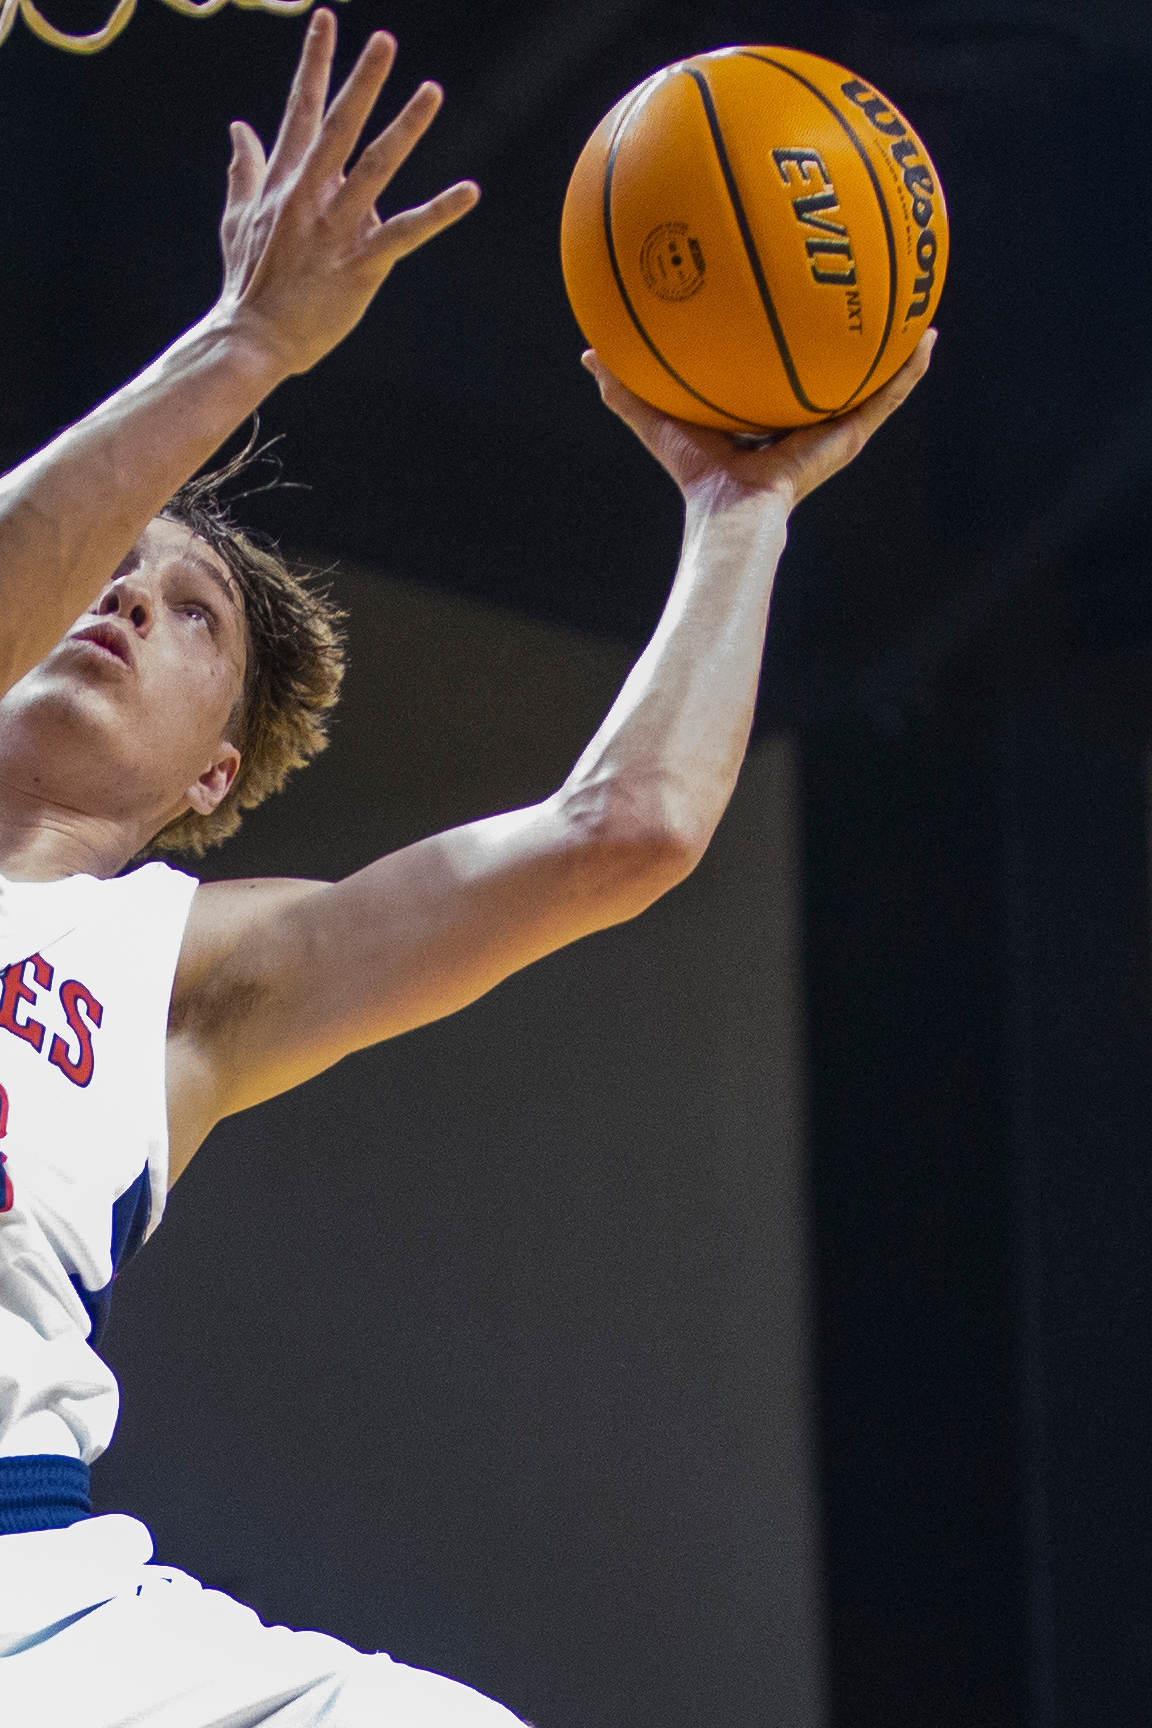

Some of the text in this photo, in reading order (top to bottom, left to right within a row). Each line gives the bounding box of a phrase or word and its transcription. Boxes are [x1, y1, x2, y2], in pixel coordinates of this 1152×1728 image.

[772, 147, 863, 335] EVO NXT
[840, 79, 938, 322] Wilson
